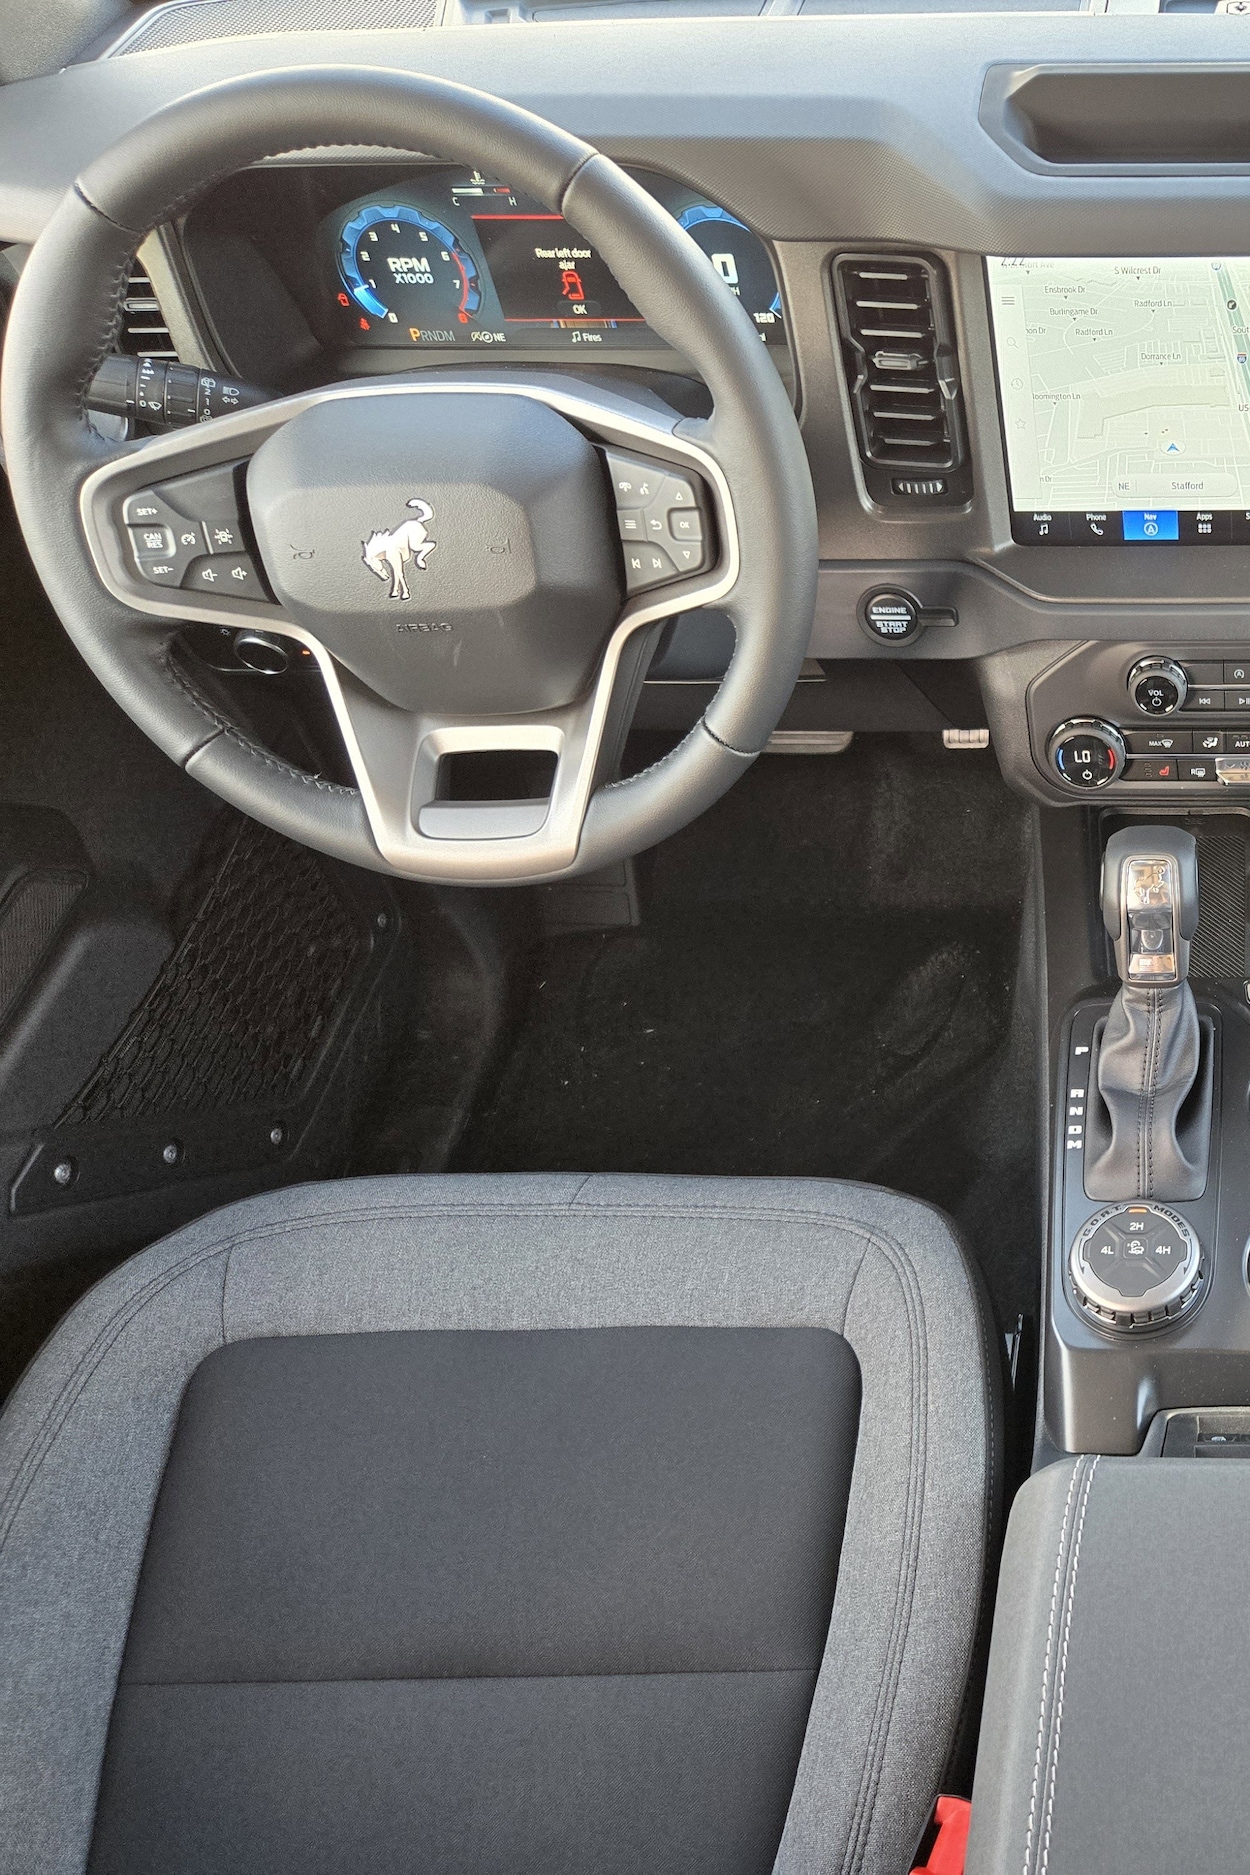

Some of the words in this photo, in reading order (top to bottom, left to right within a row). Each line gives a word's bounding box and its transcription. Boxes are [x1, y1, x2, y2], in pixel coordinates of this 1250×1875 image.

[452, 197, 460, 206] C
[509, 197, 517, 206] H
[391, 223, 400, 233] 4
[368, 232, 378, 241] 3
[419, 232, 428, 241] 5
[360, 252, 370, 261] 2
[441, 252, 450, 261] 6
[535, 248, 555, 258] Rear
[555, 248, 572, 258] left
[573, 248, 591, 258] door
[387, 257, 431, 273] RPM
[559, 260, 575, 271] ajar
[711, 253, 738, 284] 0
[393, 274, 434, 284] X1000
[369, 280, 376, 288] 1
[453, 280, 460, 289] 7
[573, 305, 587, 314] OK
[1050, 307, 1089, 316] Burlingame
[1090, 307, 1098, 315] Dr
[388, 312, 398, 323] 0
[753, 313, 776, 323] 120
[1075, 328, 1103, 336] Radford
[493, 333, 506, 342] NE
[583, 332, 602, 342] Fires
[1118, 482, 1130, 490] NE
[1171, 481, 1204, 490] Stafford
[136, 508, 158, 516] SET+
[1033, 513, 1052, 521] Audio
[1086, 513, 1107, 521] Phone
[1196, 513, 1212, 522] Apps
[144, 533, 162, 541] CAN
[153, 566, 174, 574] SET-
[872, 606, 907, 614] ENGINE
[1074, 750, 1091, 763] LO
[1075, 1046, 1089, 1055] P
[1069, 1106, 1084, 1115] N
[1068, 1125, 1082, 1135] D
[1067, 1140, 1082, 1149] M
[1153, 1205, 1190, 1237] MODES
[1129, 1222, 1144, 1231] 2H
[1100, 1246, 1115, 1255] 4L
[1155, 1246, 1171, 1255] 4H
